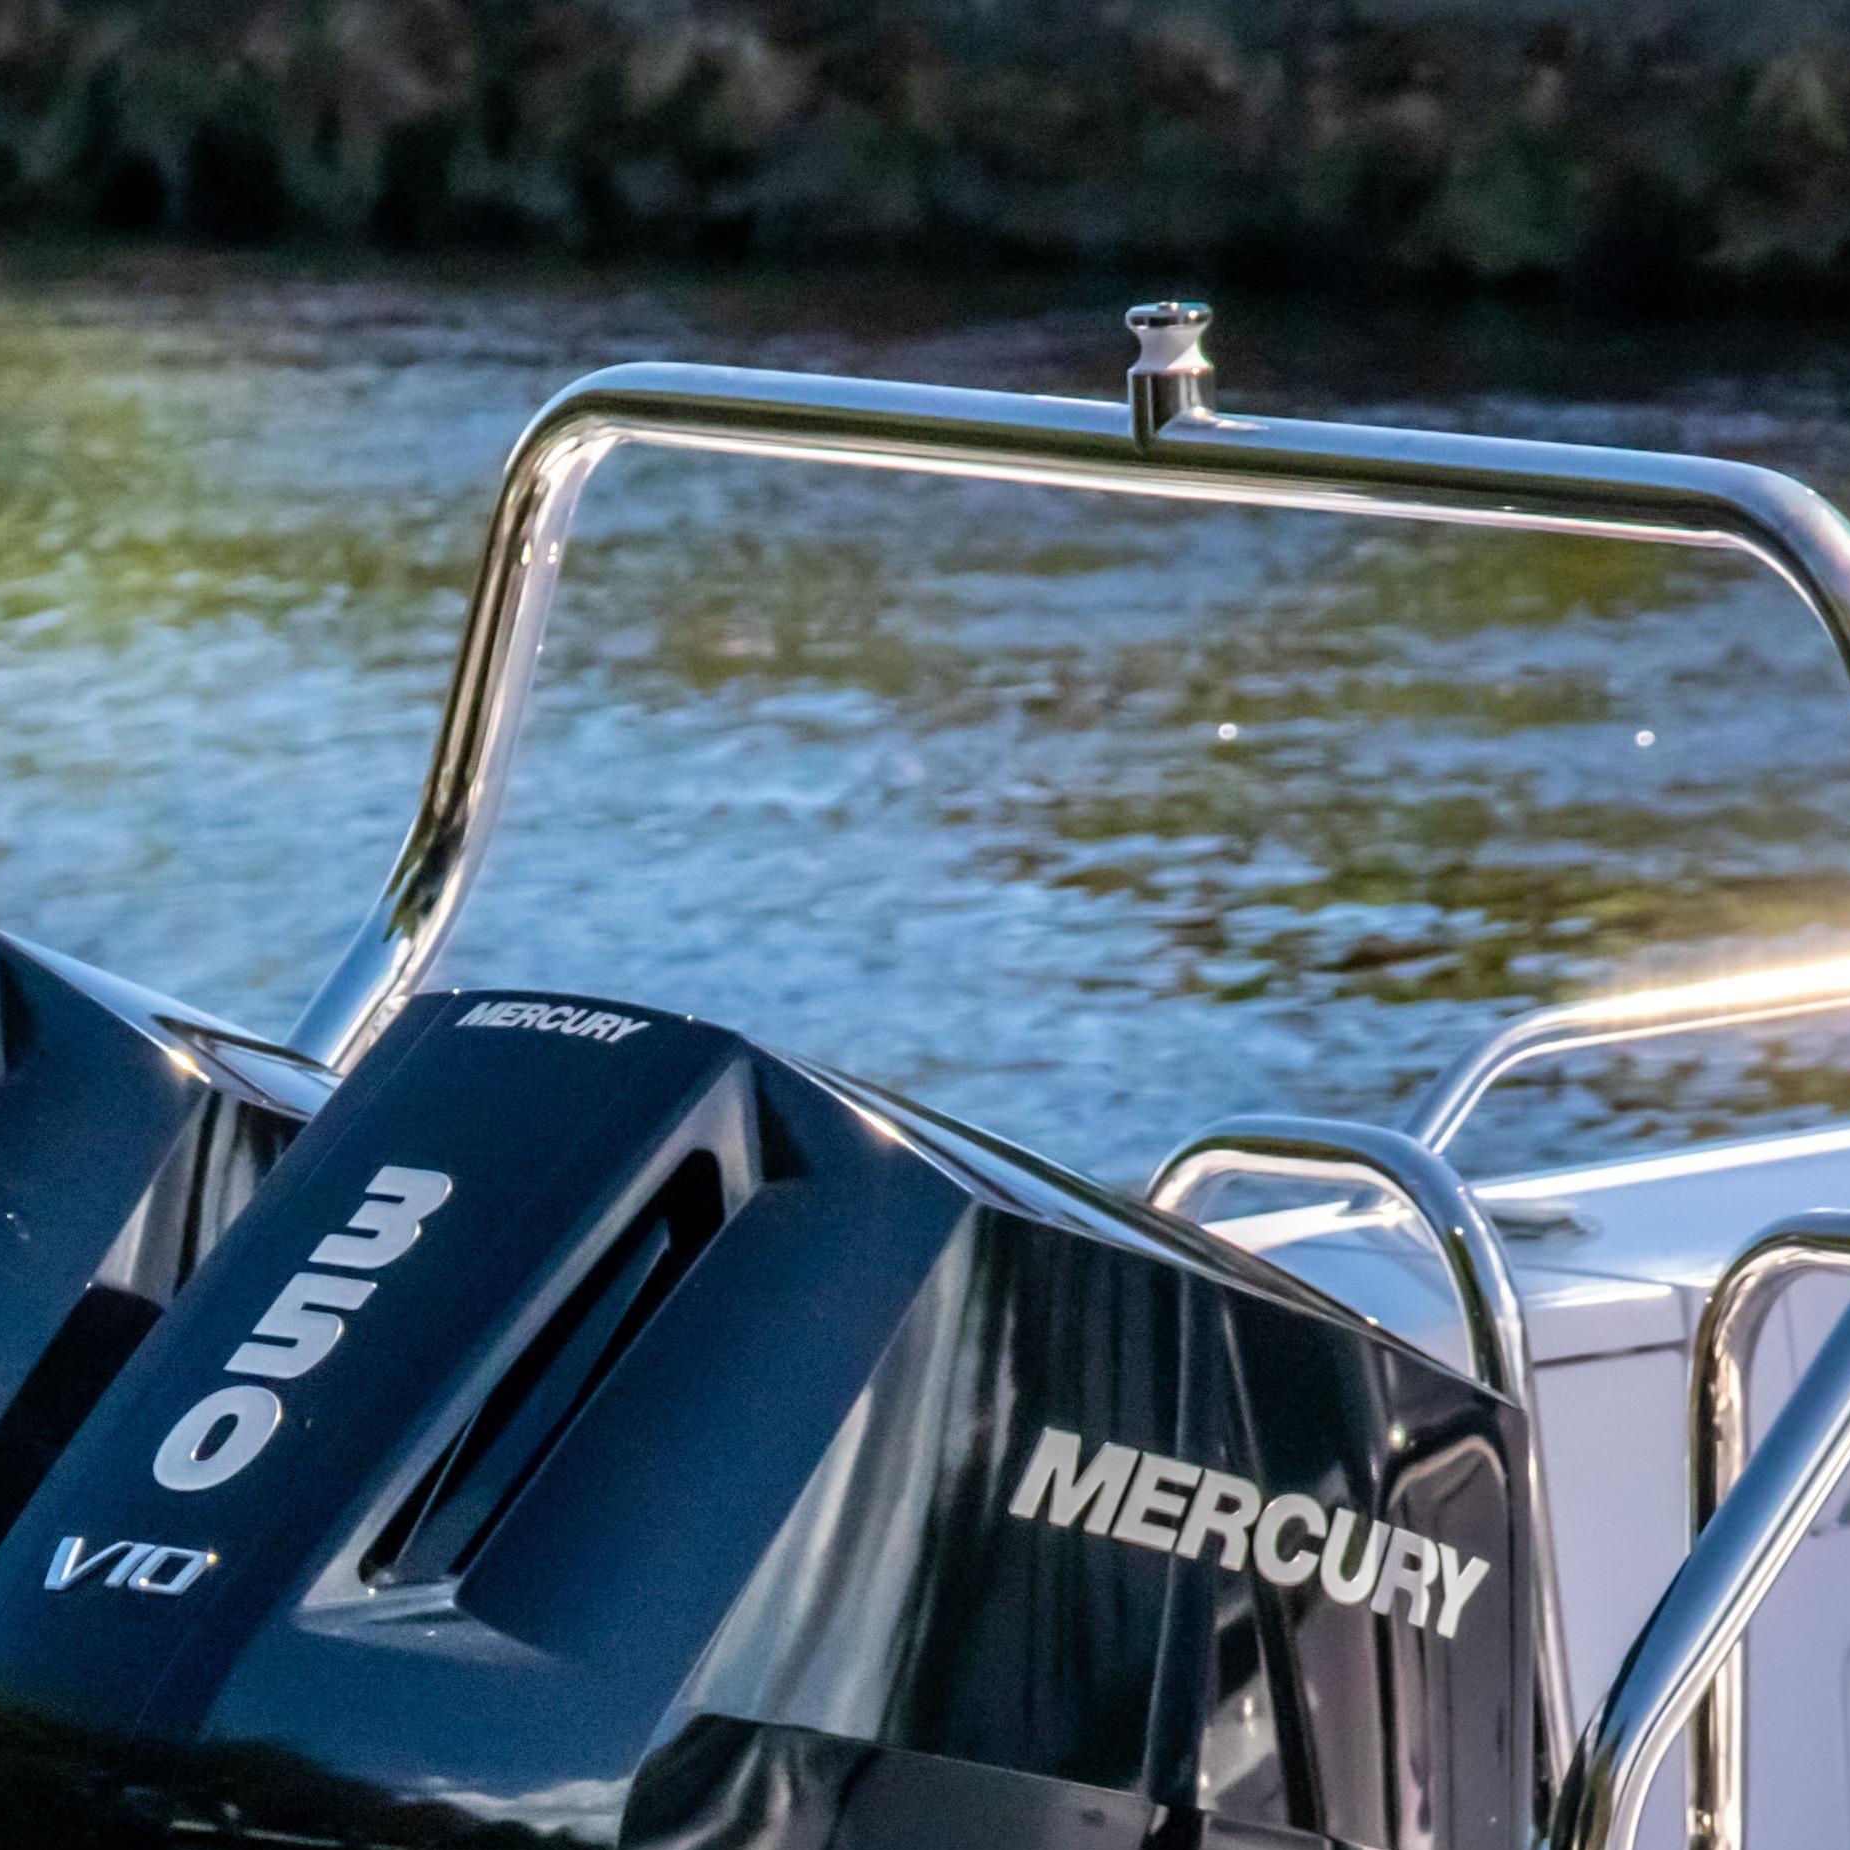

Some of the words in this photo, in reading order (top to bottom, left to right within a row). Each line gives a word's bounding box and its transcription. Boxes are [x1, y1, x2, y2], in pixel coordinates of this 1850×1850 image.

[455, 1001, 651, 1044] MERCURY
[153, 1165, 454, 1492] 350
[44, 1535, 219, 1595] V10
[1008, 1426, 1491, 1640] MERCURY
